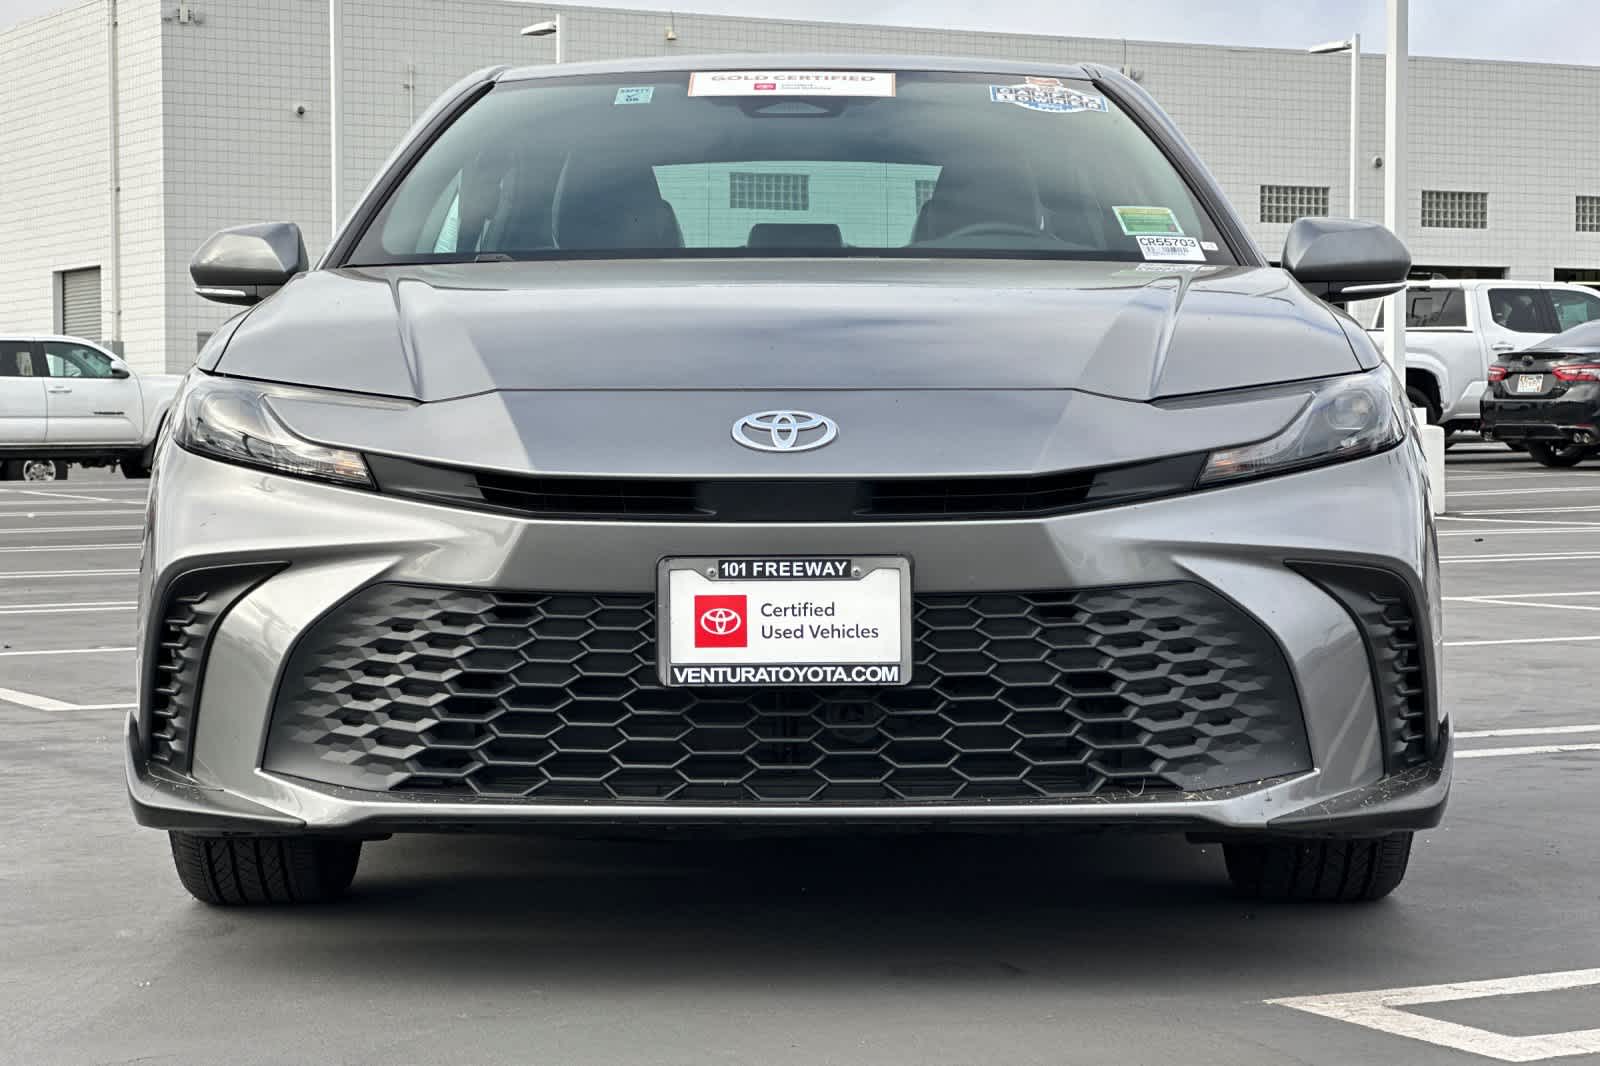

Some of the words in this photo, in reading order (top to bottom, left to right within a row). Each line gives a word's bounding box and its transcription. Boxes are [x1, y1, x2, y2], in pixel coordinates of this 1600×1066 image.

[711, 74, 769, 82] GOLD
[773, 74, 877, 82] CERTIFIED
[1139, 237, 1197, 247] CR55703
[721, 562, 747, 577] 101
[753, 561, 848, 577] FREEWAY
[760, 602, 836, 617] Certified
[761, 624, 805, 639] Used
[809, 624, 880, 639] Vehicles
[673, 665, 900, 684] VENTURATOYOTA.COM
